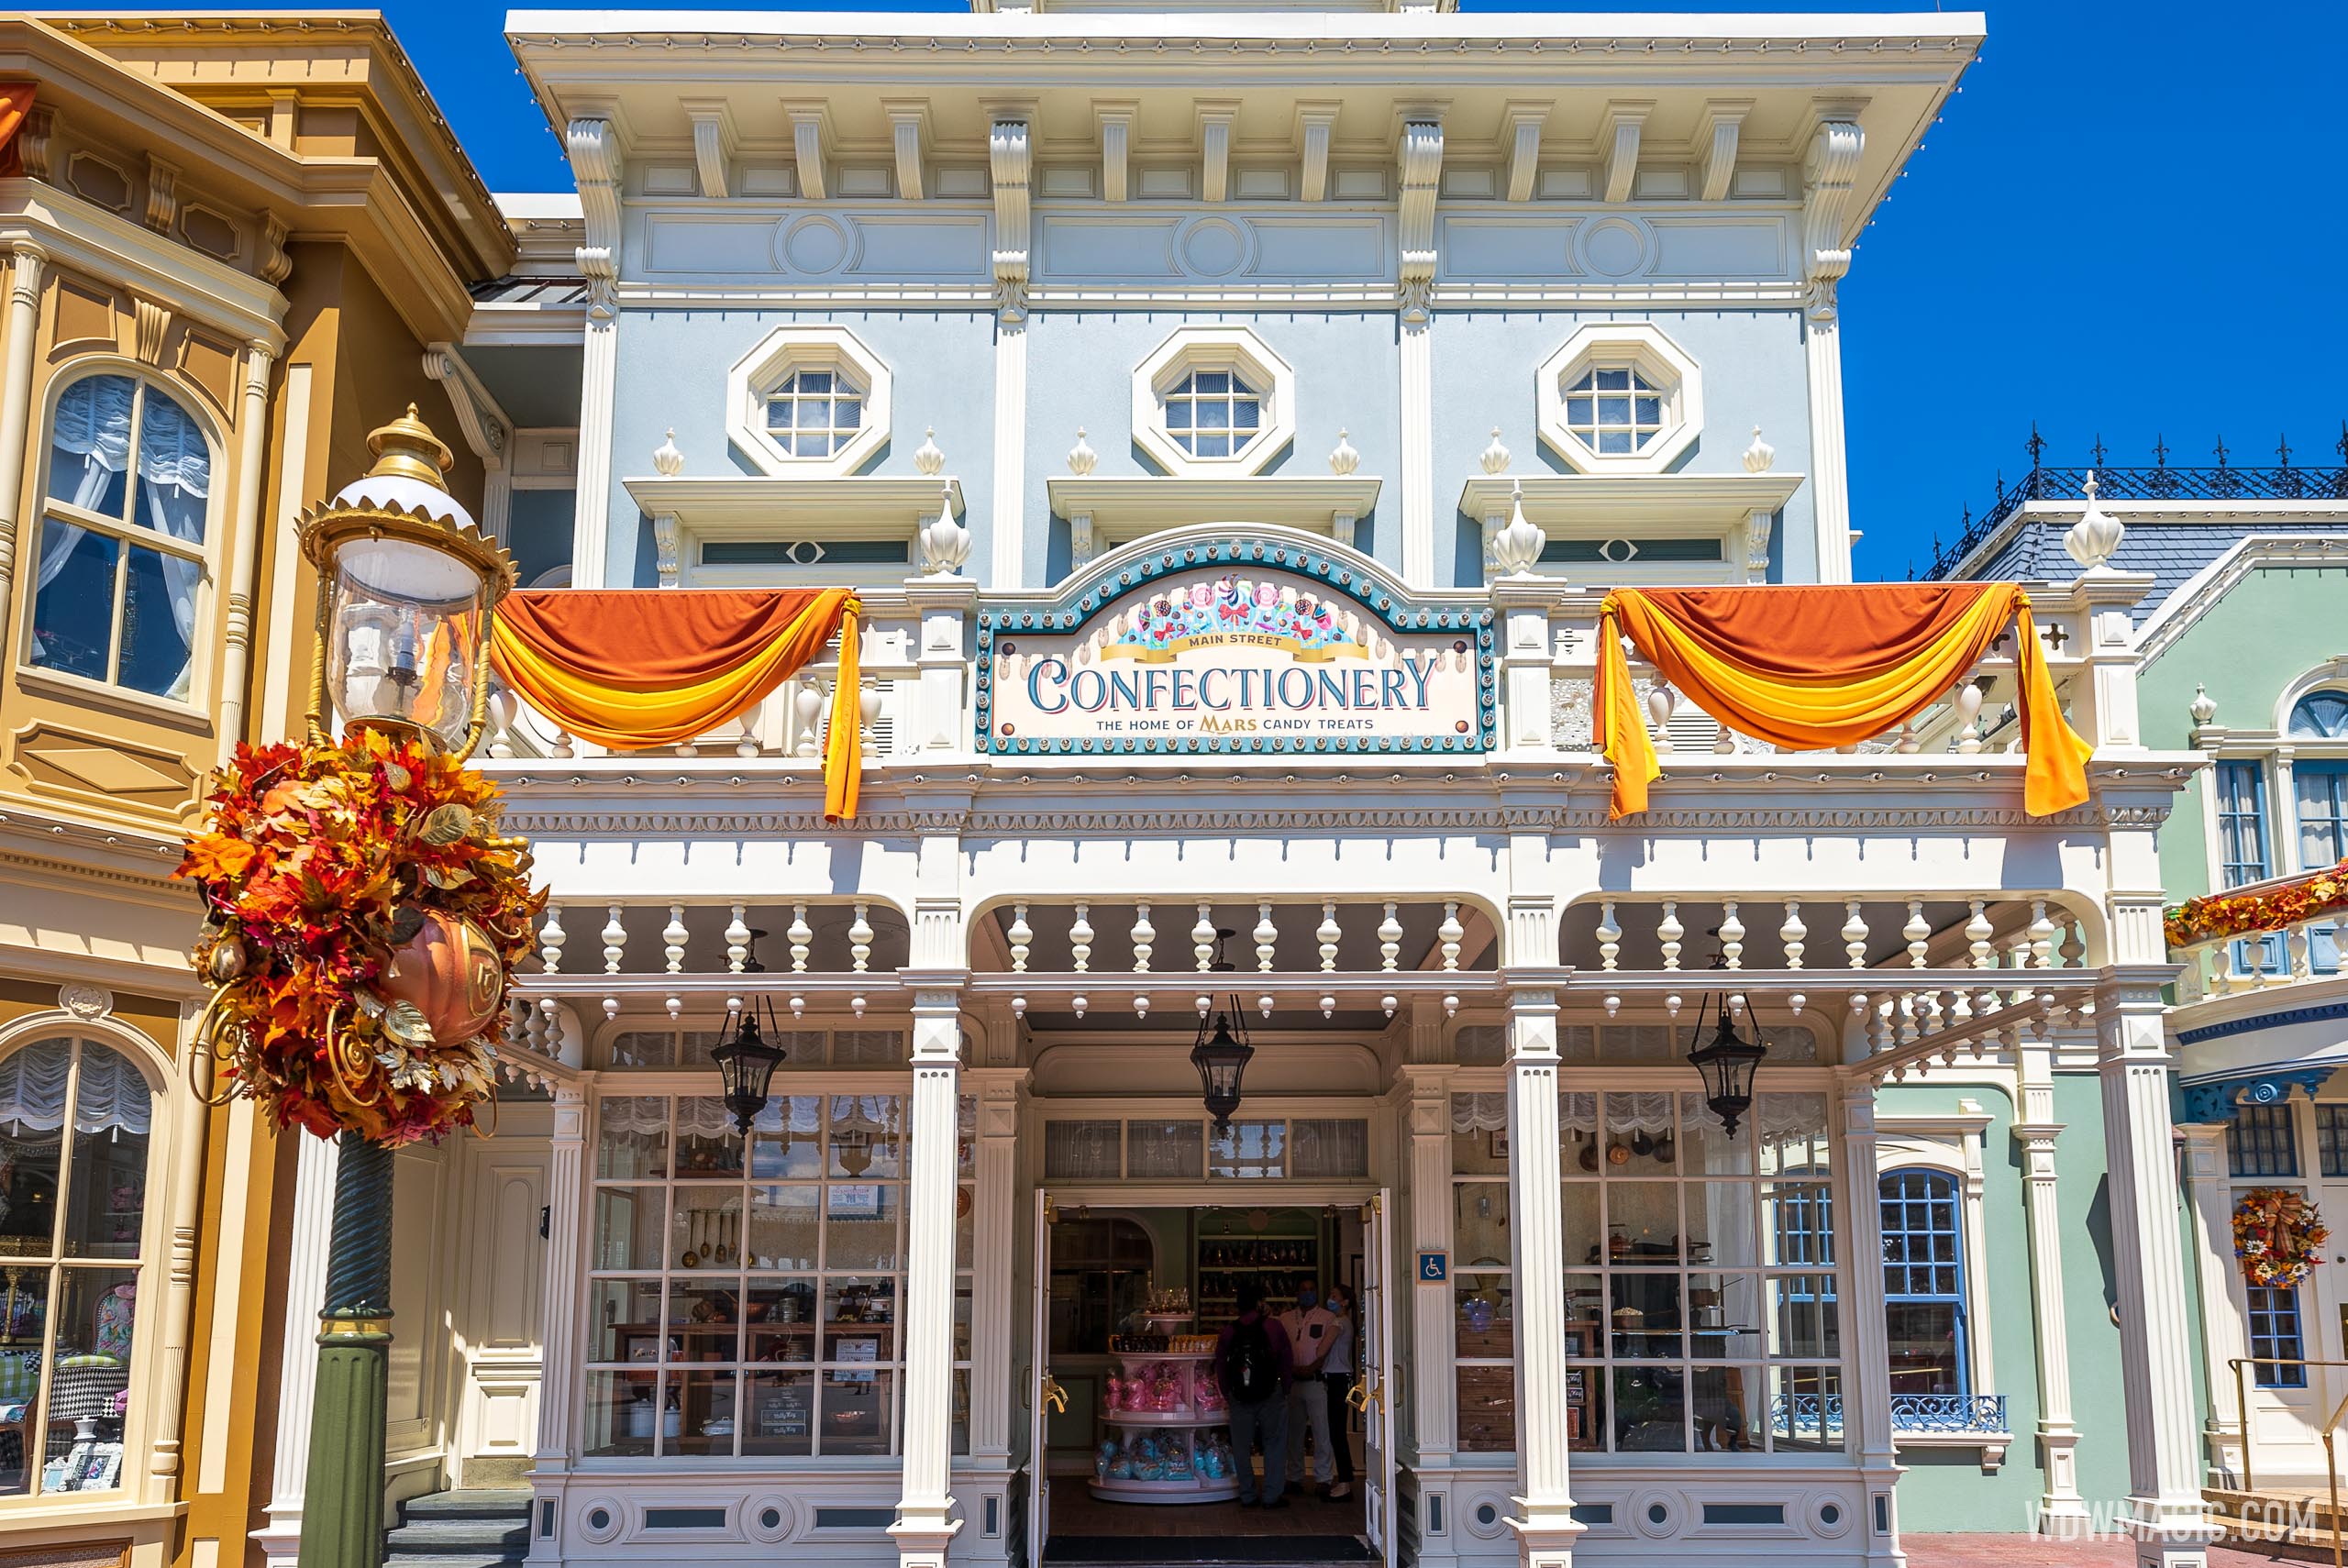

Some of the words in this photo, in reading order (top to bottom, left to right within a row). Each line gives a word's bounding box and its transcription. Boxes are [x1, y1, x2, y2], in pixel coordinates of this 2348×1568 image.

[1189, 635, 1224, 646] MAIN
[1230, 634, 1282, 646] STREET
[1027, 657, 1439, 713] CONFECTIONERY
[1096, 721, 1123, 731] THE
[1129, 720, 1170, 730] HOME
[1176, 720, 1194, 730] OF
[1199, 714, 1257, 734] MARS
[1263, 719, 1311, 730] CANDY
[1318, 719, 1374, 730] TREATS
